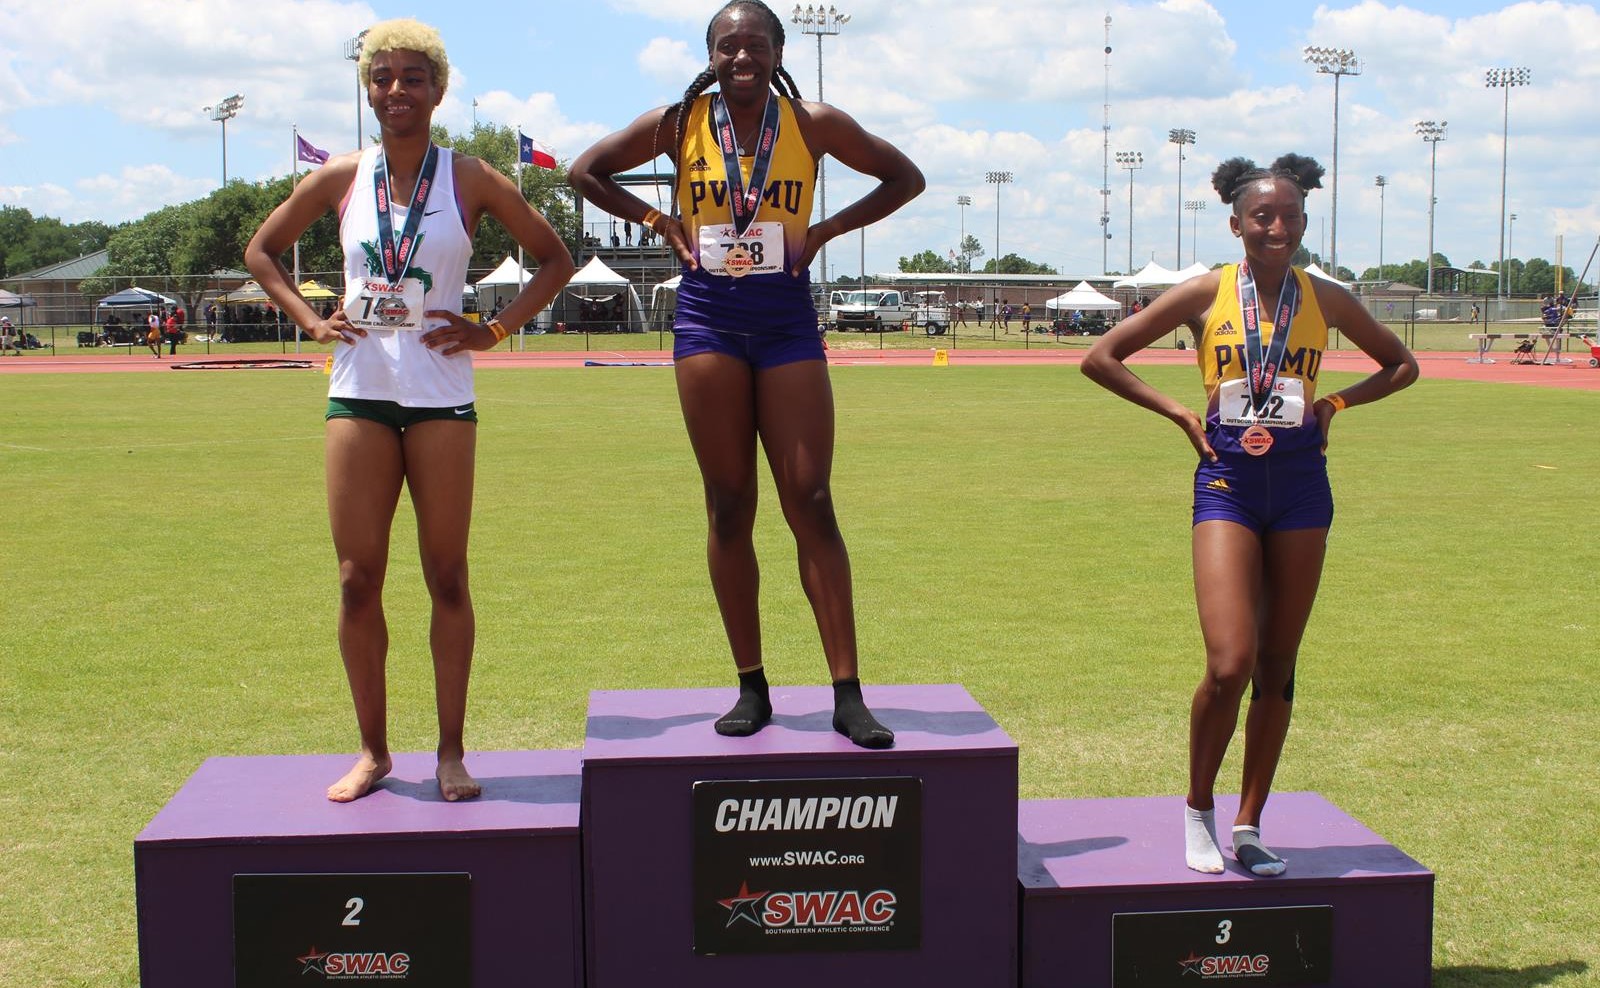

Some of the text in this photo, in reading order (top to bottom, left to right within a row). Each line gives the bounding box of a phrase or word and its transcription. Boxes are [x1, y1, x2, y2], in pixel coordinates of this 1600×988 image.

[690, 180, 803, 215] PVMU
[731, 228, 763, 237] SAC
[1241, 395, 1284, 419] 72
[715, 796, 898, 832] CHAMPION
[341, 897, 364, 926] 2
[763, 890, 897, 927] SWAC
[848, 925, 890, 933] CONFERENCE
[1215, 919, 1233, 944] 3
[325, 953, 410, 975] SWAC
[1201, 955, 1269, 975] SWAC
